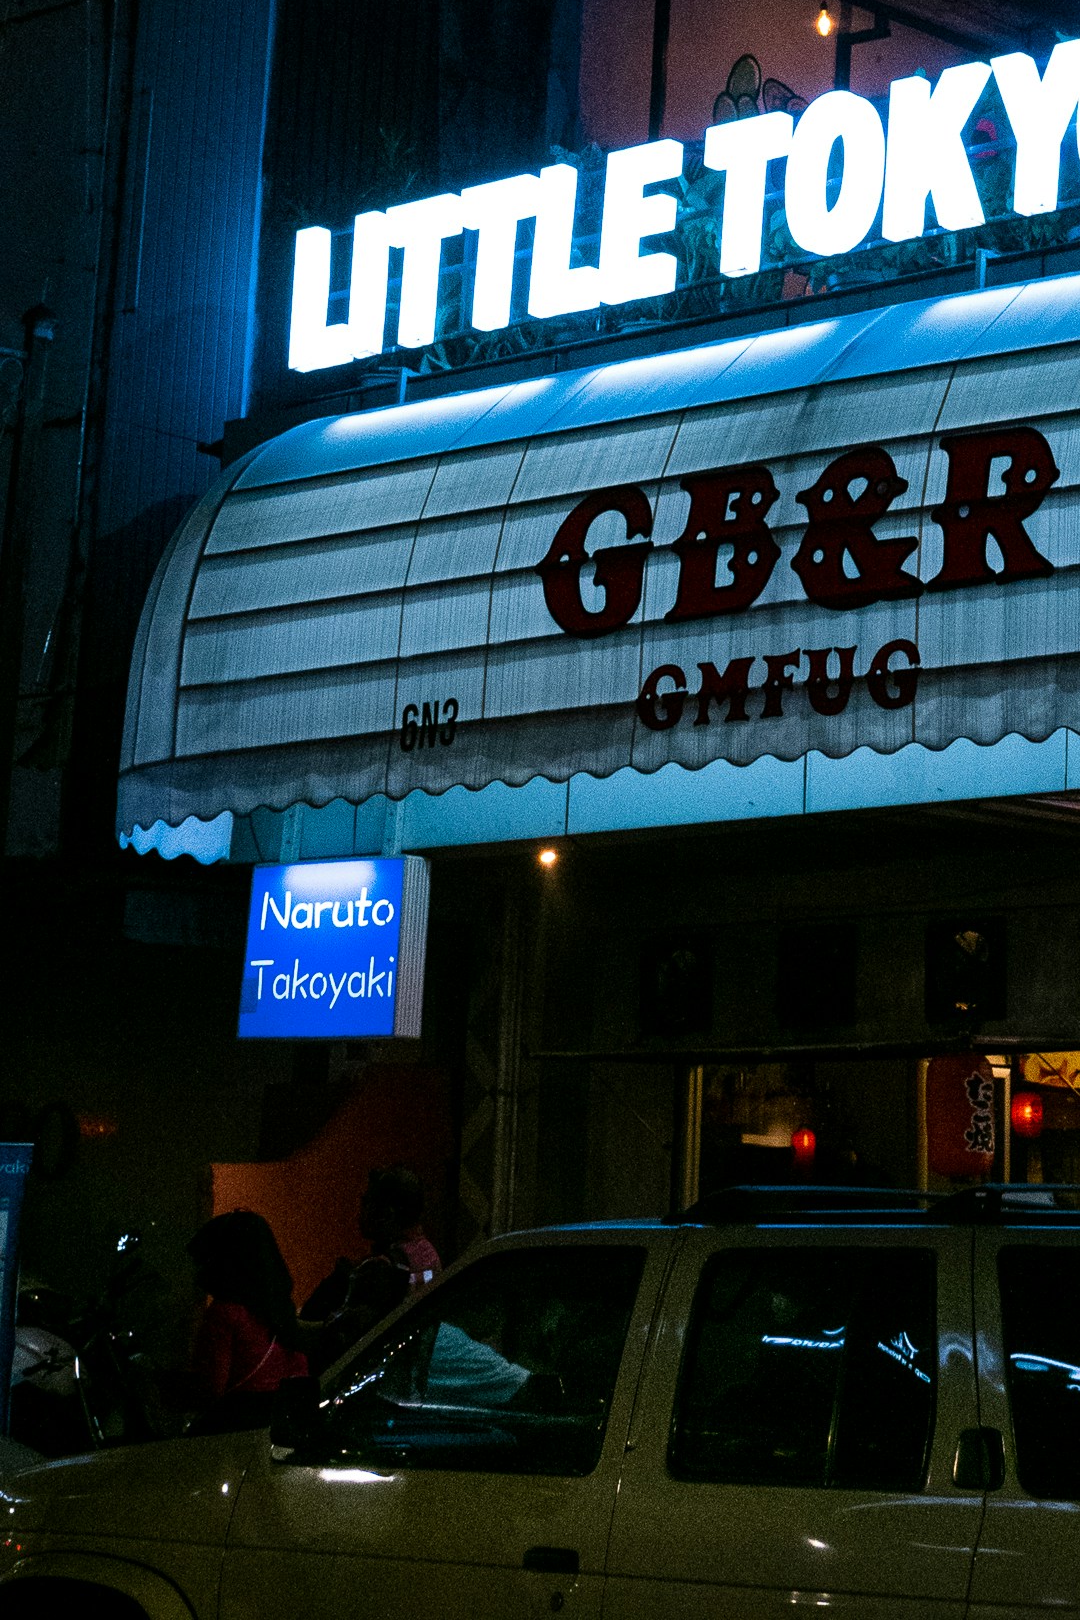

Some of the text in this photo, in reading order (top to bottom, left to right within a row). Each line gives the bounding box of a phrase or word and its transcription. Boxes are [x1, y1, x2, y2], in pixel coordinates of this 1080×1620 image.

[288, 138, 684, 373] LITTLE
[534, 426, 1061, 639] GB&R
[636, 638, 922, 731] GMFUG
[399, 697, 460, 754] 6N3
[260, 886, 395, 931] Naruto
[250, 956, 396, 1010] Takoyaki
